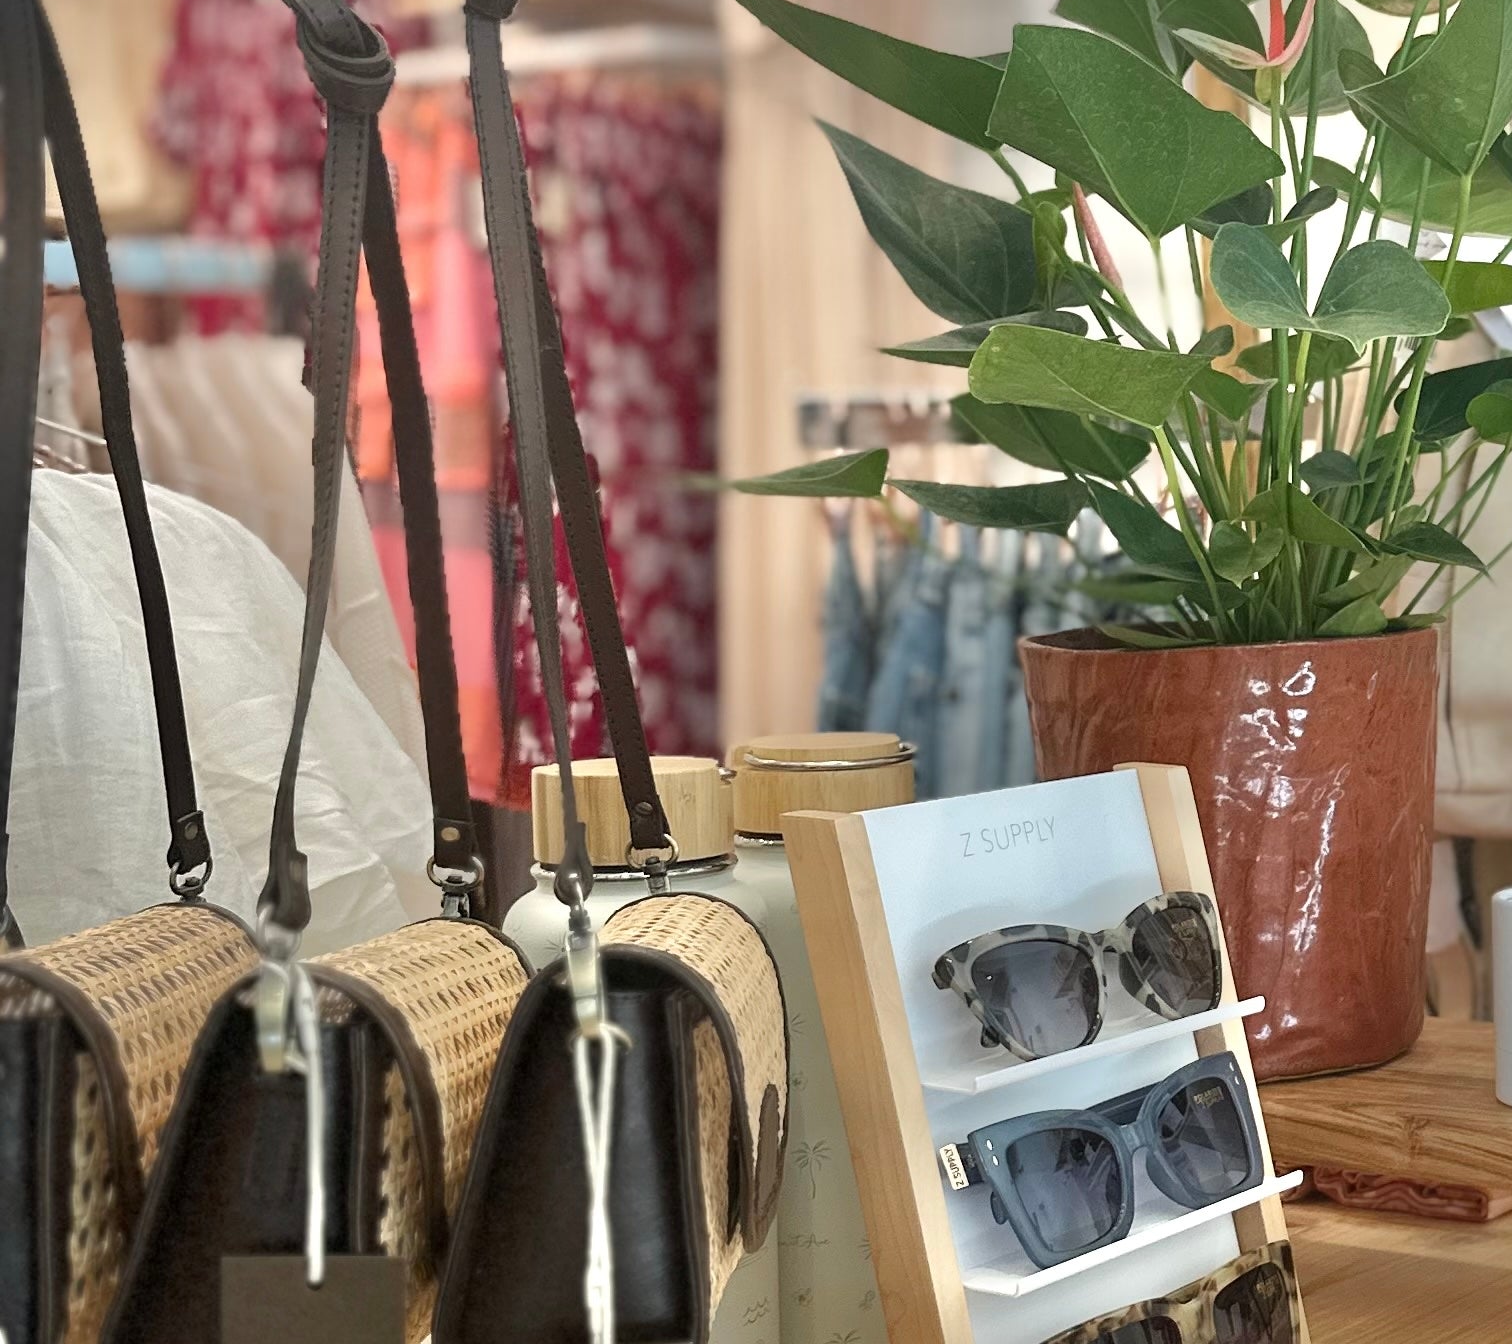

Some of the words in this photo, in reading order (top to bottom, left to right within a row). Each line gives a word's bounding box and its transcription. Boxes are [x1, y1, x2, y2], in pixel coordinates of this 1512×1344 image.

[960, 832, 976, 857] Z
[980, 815, 1055, 853] SUPPLY
[943, 1148, 962, 1179] SUPPLY
